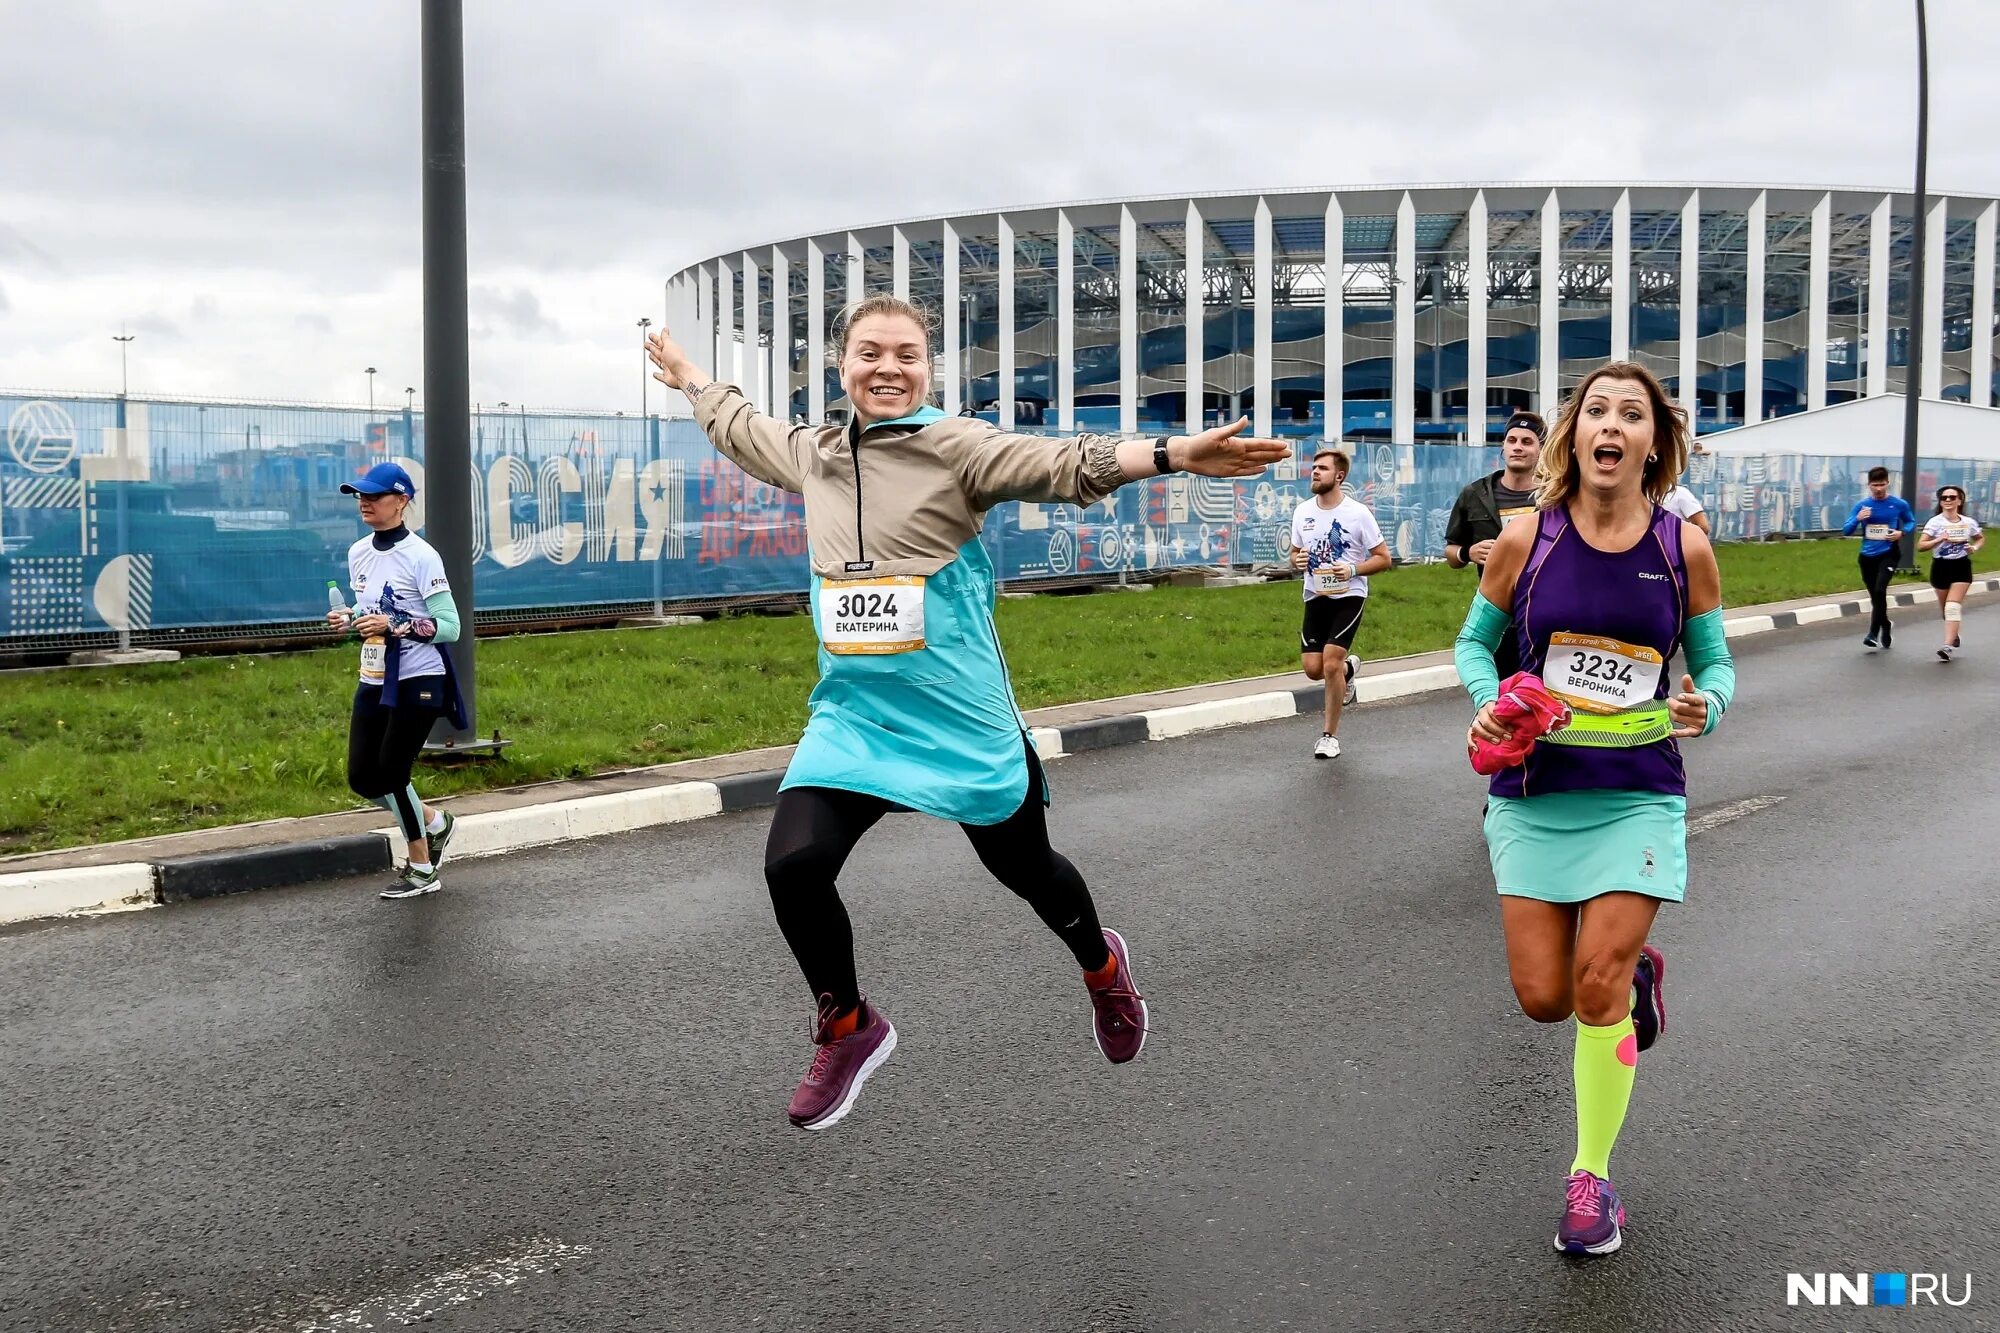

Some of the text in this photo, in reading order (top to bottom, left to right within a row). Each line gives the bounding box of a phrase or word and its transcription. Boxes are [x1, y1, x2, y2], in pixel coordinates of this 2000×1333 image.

[1321, 575, 1341, 584] 392
[1638, 572, 1664, 581] CRAFT
[836, 593, 898, 618] 3024
[835, 622, 899, 633] ЕКАТЕРИНА
[1569, 651, 1634, 686] 3234
[1567, 675, 1627, 699] ВЕРОНИКА
